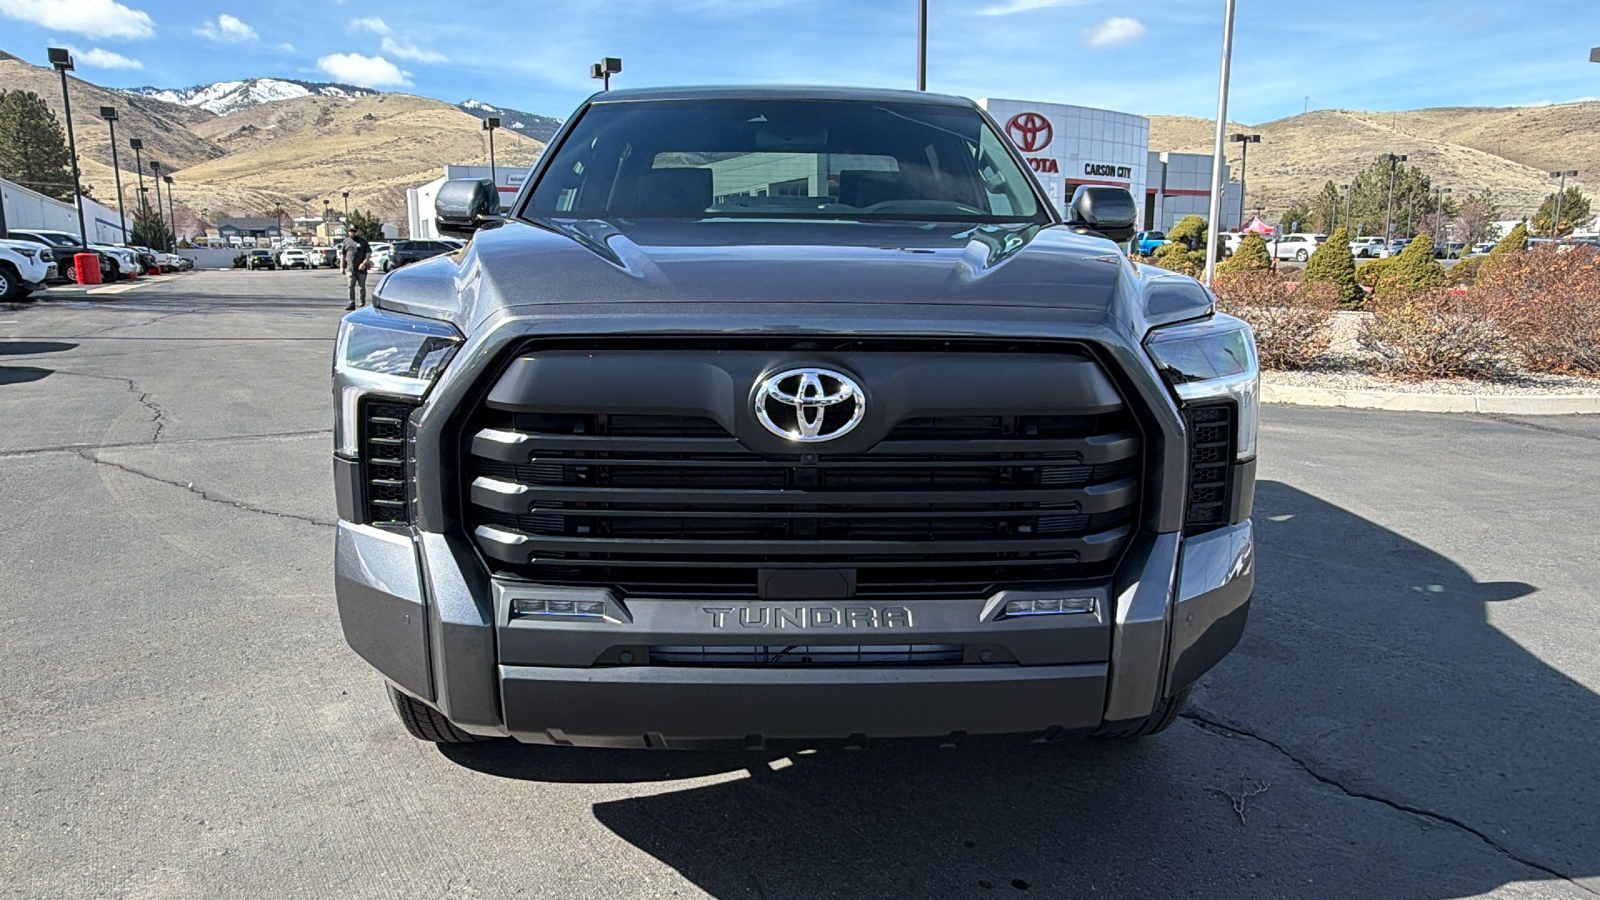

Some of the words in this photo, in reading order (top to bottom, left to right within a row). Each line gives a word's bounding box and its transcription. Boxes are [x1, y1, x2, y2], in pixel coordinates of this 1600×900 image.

[1084, 162, 1116, 177] CARSON
[1116, 166, 1132, 179] CITY
[702, 606, 914, 629] TUNDRA
